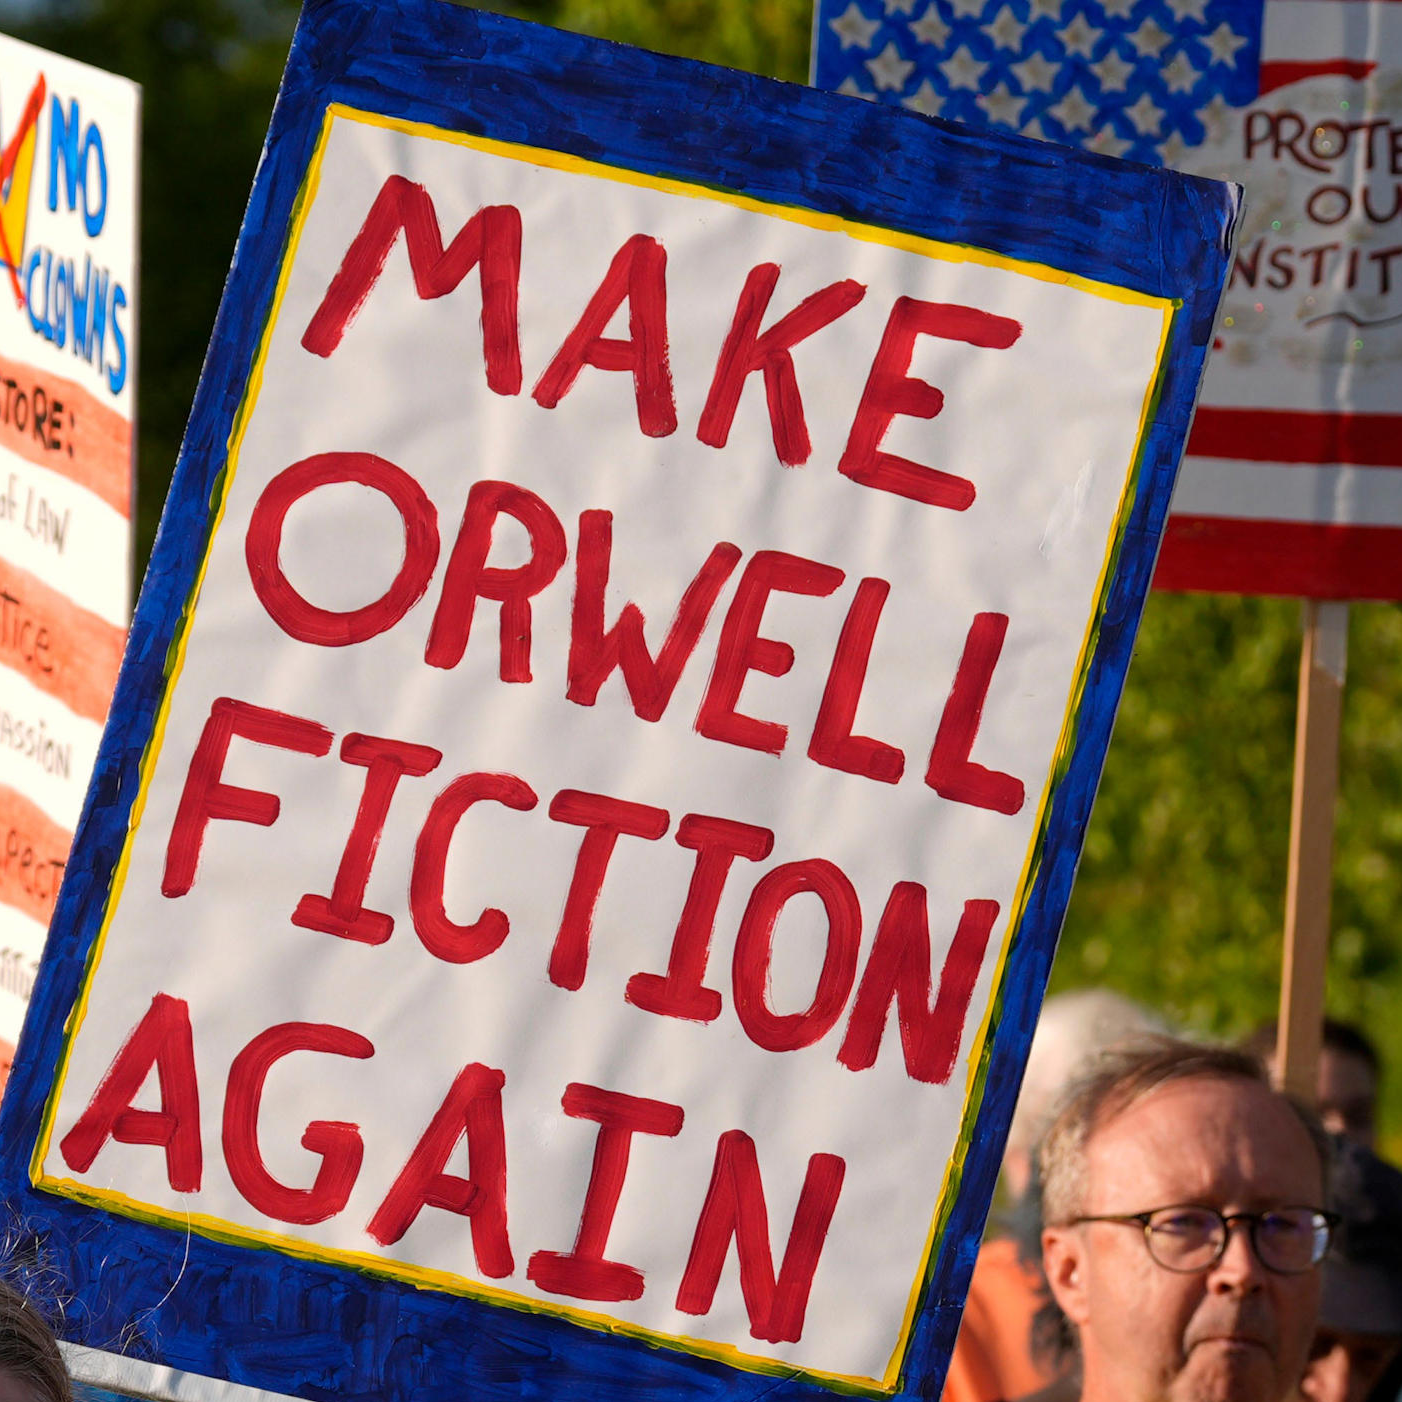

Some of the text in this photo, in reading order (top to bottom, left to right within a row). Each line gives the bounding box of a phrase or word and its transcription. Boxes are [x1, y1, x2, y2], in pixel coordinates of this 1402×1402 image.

[27, 247, 128, 396] CLOWNS
[49, 93, 108, 238] NO
[300, 174, 1024, 512] MAKE
[24, 487, 72, 554] LAW
[244, 450, 1026, 816] ORWELL
[159, 696, 1001, 1085] FICTION
[59, 991, 846, 1344] AGAIN
